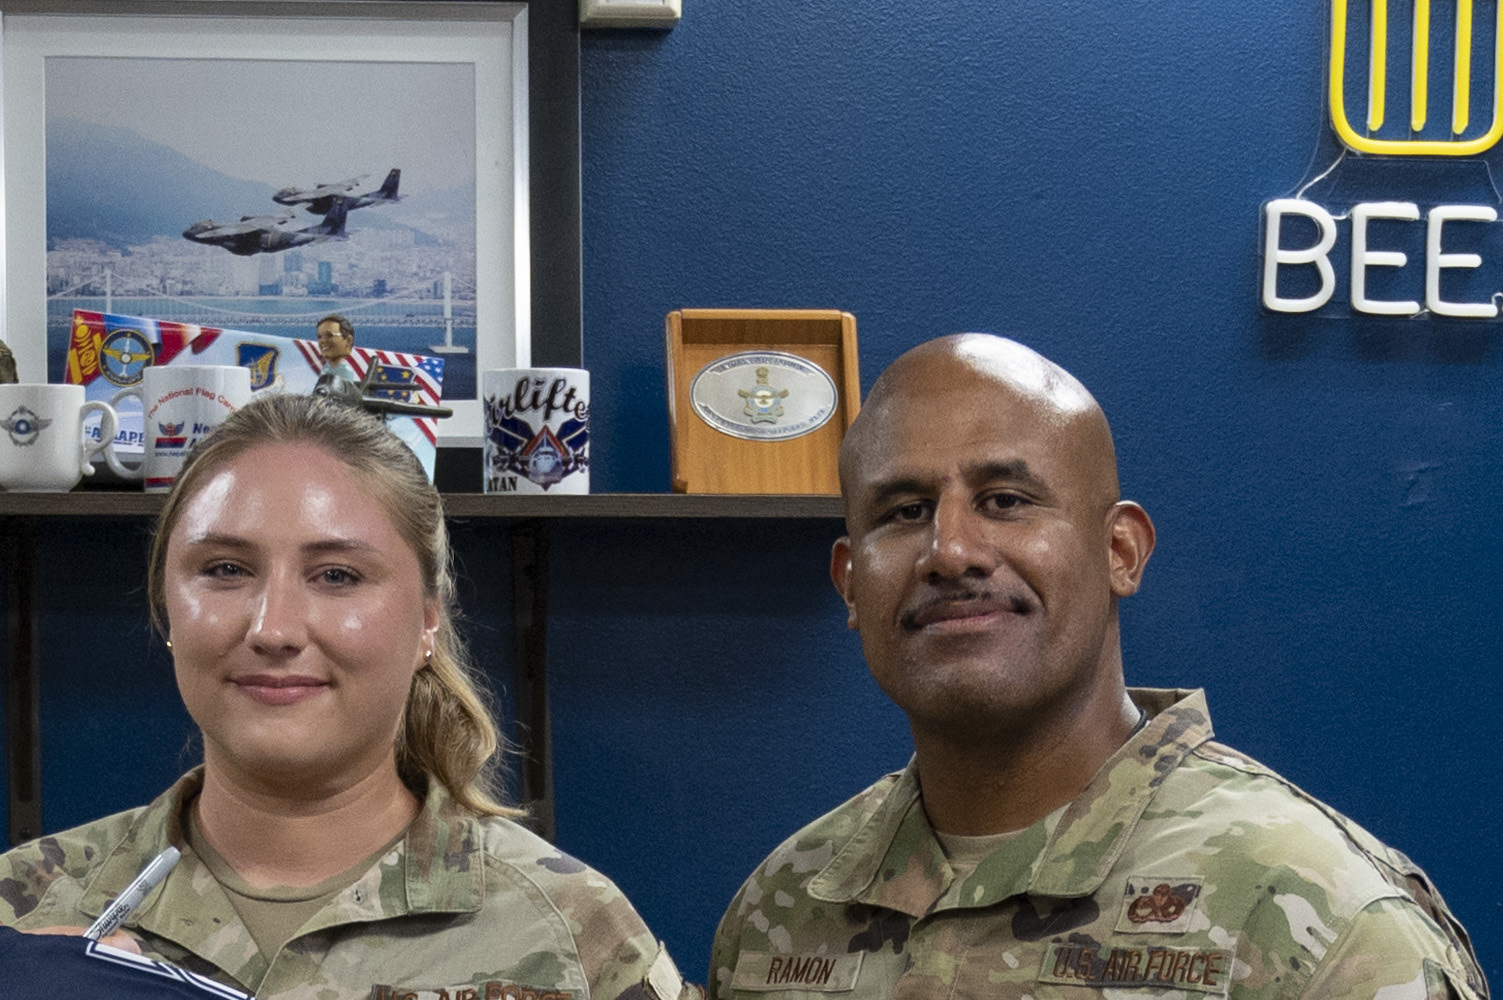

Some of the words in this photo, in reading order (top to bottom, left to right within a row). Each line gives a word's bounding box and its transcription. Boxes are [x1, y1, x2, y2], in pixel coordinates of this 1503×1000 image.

[1262, 200, 1499, 317] BEE
[158, 388, 193, 406] National
[196, 387, 216, 400] Flag
[766, 957, 836, 984] RAMON
[1052, 947, 1095, 980] U.S.
[1102, 947, 1143, 981] AIR
[1144, 949, 1222, 986] FORCE
